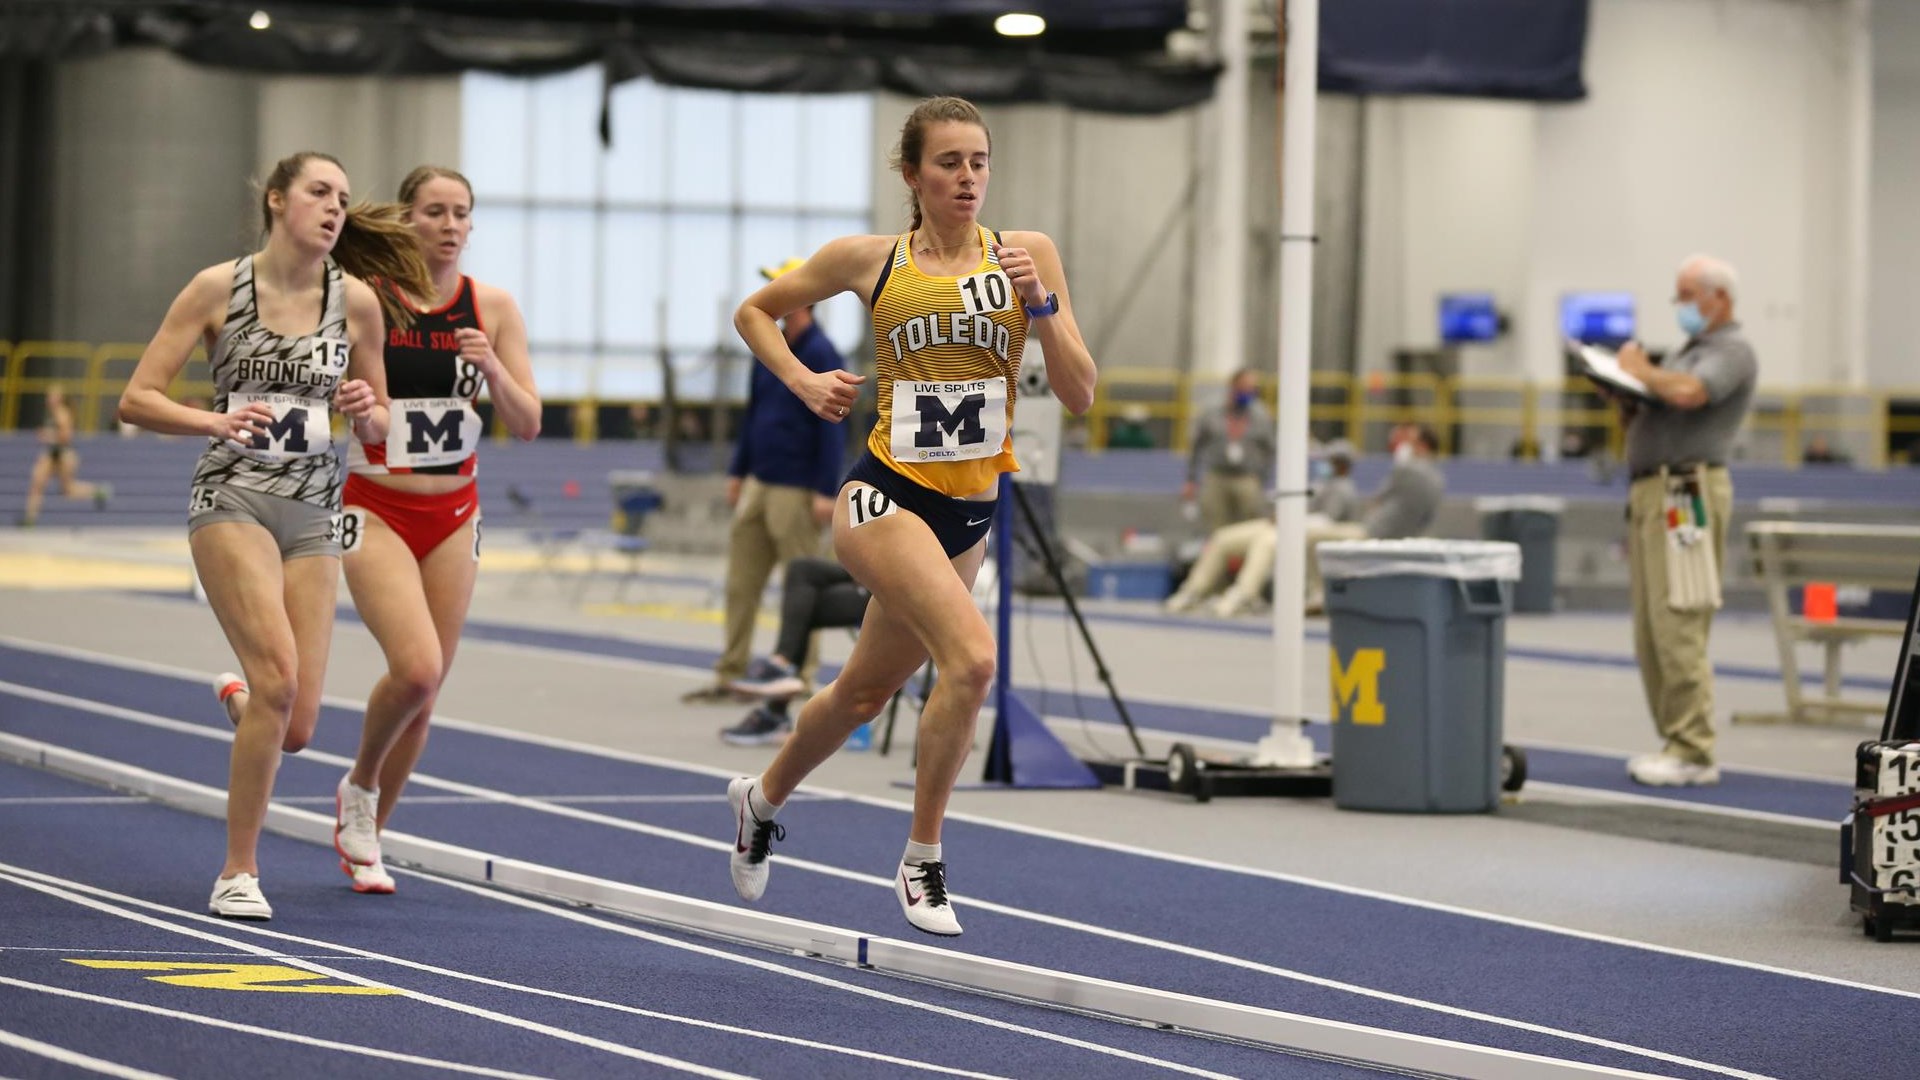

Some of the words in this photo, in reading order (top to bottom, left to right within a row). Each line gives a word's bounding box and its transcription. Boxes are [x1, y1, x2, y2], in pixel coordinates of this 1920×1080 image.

[963, 273, 1007, 313] 10
[315, 341, 347, 368] 15
[389, 328, 424, 349] BALL
[430, 331, 460, 351] STA
[887, 312, 1010, 362] TOLEDO
[457, 361, 477, 397] 8
[914, 383, 940, 393] LIVE
[944, 381, 986, 393] SPLITS
[247, 395, 269, 403] LIVE
[245, 407, 309, 453] M
[406, 410, 464, 454] M
[914, 393, 986, 448] M
[850, 489, 889, 524] 10
[341, 513, 358, 549] 8
[1331, 646, 1385, 725] M
